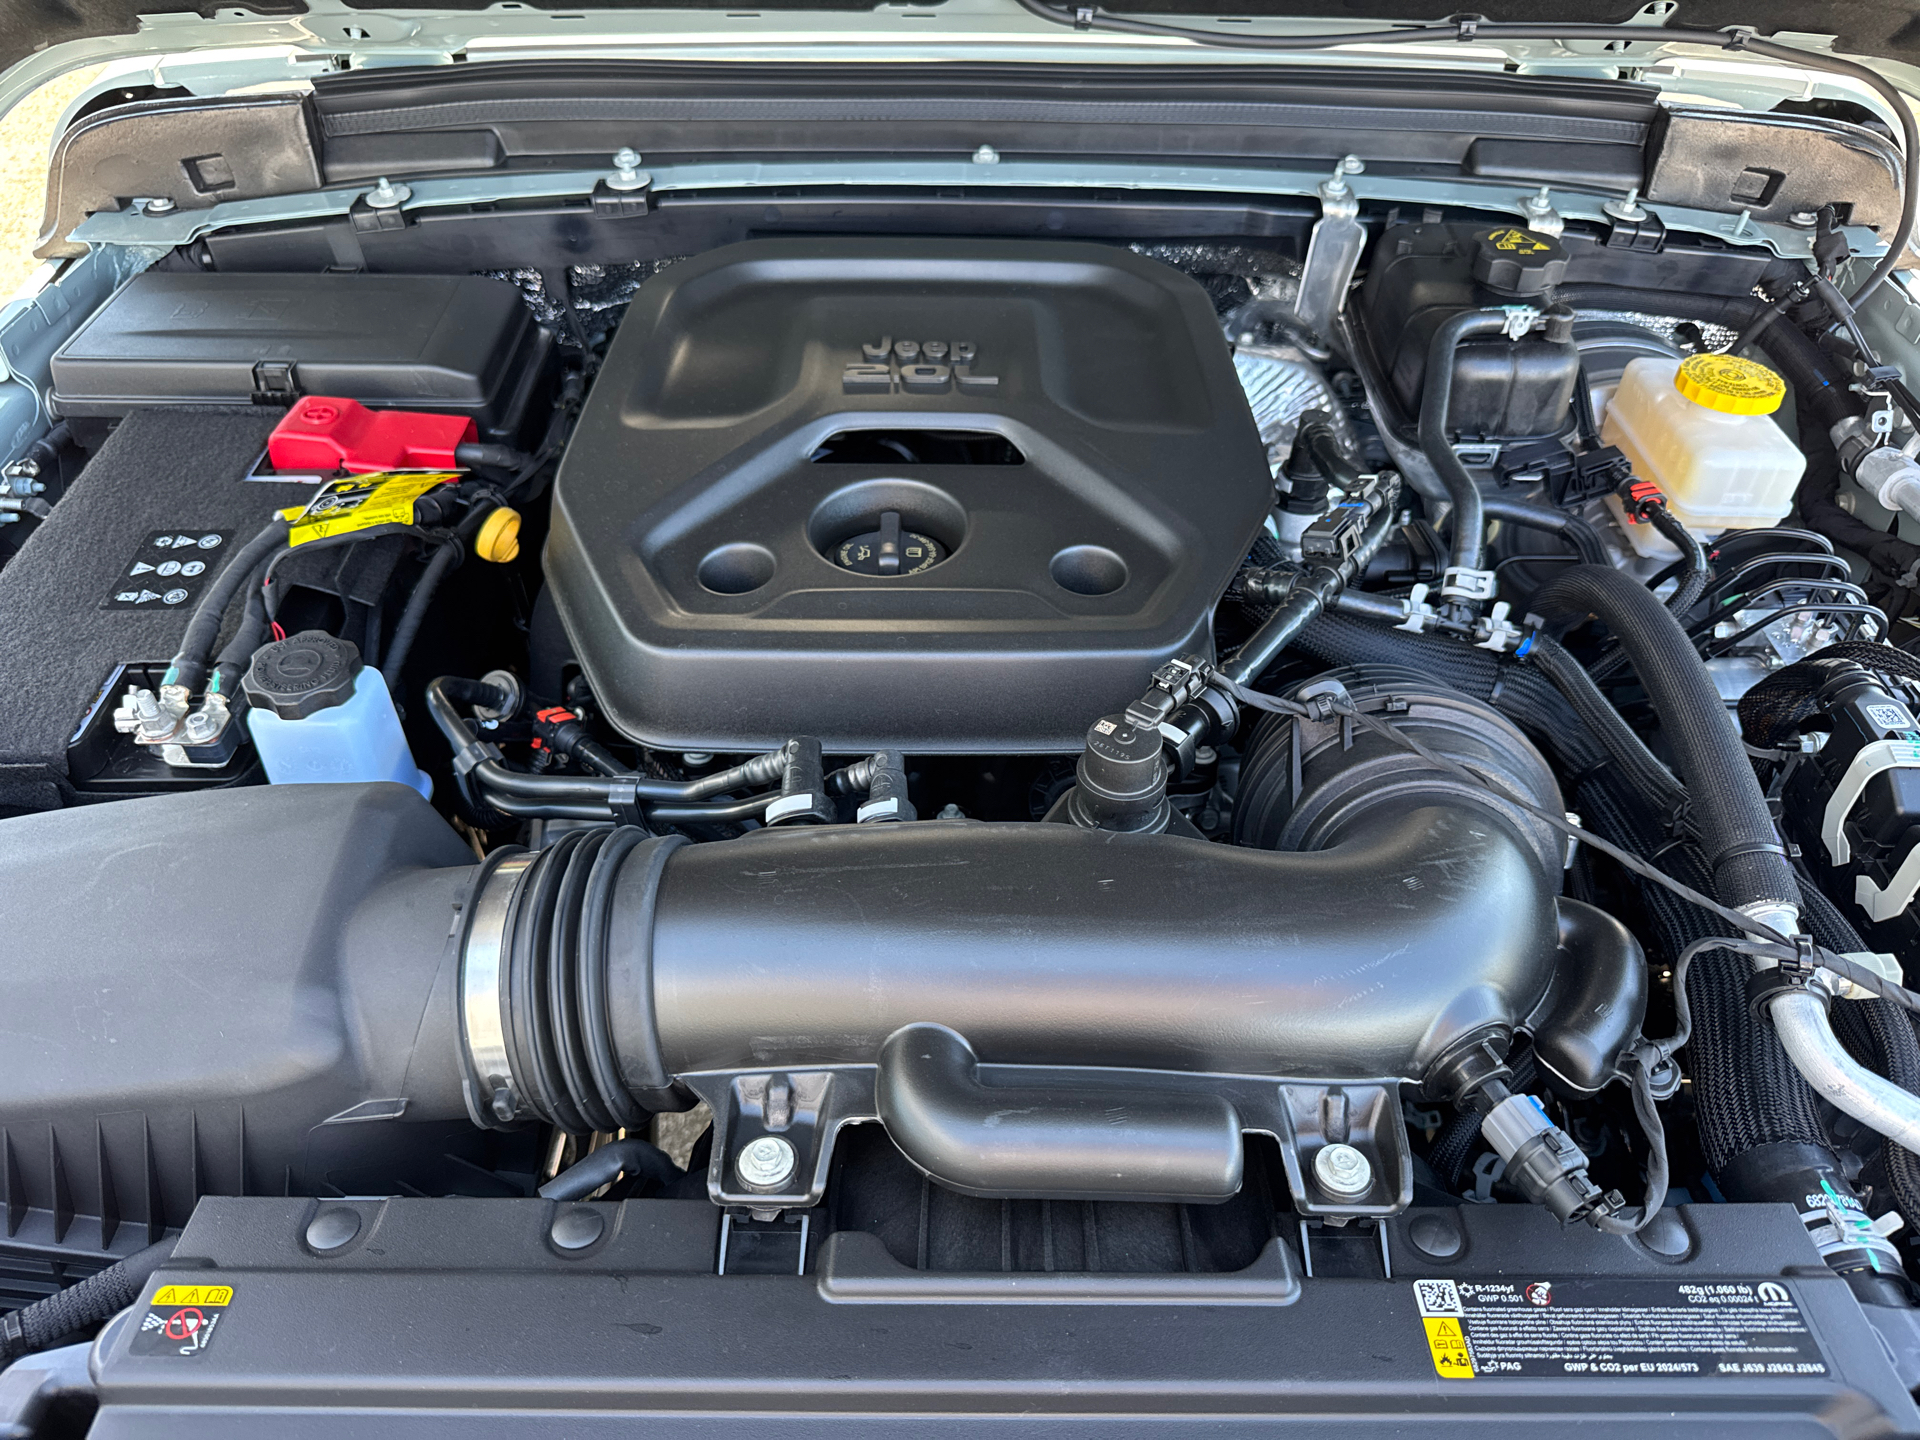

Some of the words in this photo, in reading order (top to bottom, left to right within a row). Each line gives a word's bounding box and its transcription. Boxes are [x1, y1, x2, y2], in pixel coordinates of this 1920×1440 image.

[862, 336, 977, 363] Jeep
[842, 363, 999, 390] 2.0L
[293, 635, 339, 651] APPROVED
[1475, 1285, 1514, 1294] R-1234yf
[1678, 1285, 1705, 1295] 482g
[1738, 1285, 1753, 1295] lb)
[1478, 1294, 1499, 1302] GWP
[1500, 1294, 1524, 1302] 0.501
[1688, 1295, 1708, 1303] CO2
[1709, 1296, 1721, 1304] eq
[1500, 1362, 1522, 1371] PAG
[1564, 1362, 1588, 1371] GWP
[1590, 1363, 1599, 1372] &
[1599, 1363, 1621, 1372] CO2
[1623, 1363, 1639, 1373] per
[1640, 1363, 1655, 1372] EU
[1656, 1363, 1700, 1373] 2024/573
[1718, 1363, 1741, 1373] SAE
